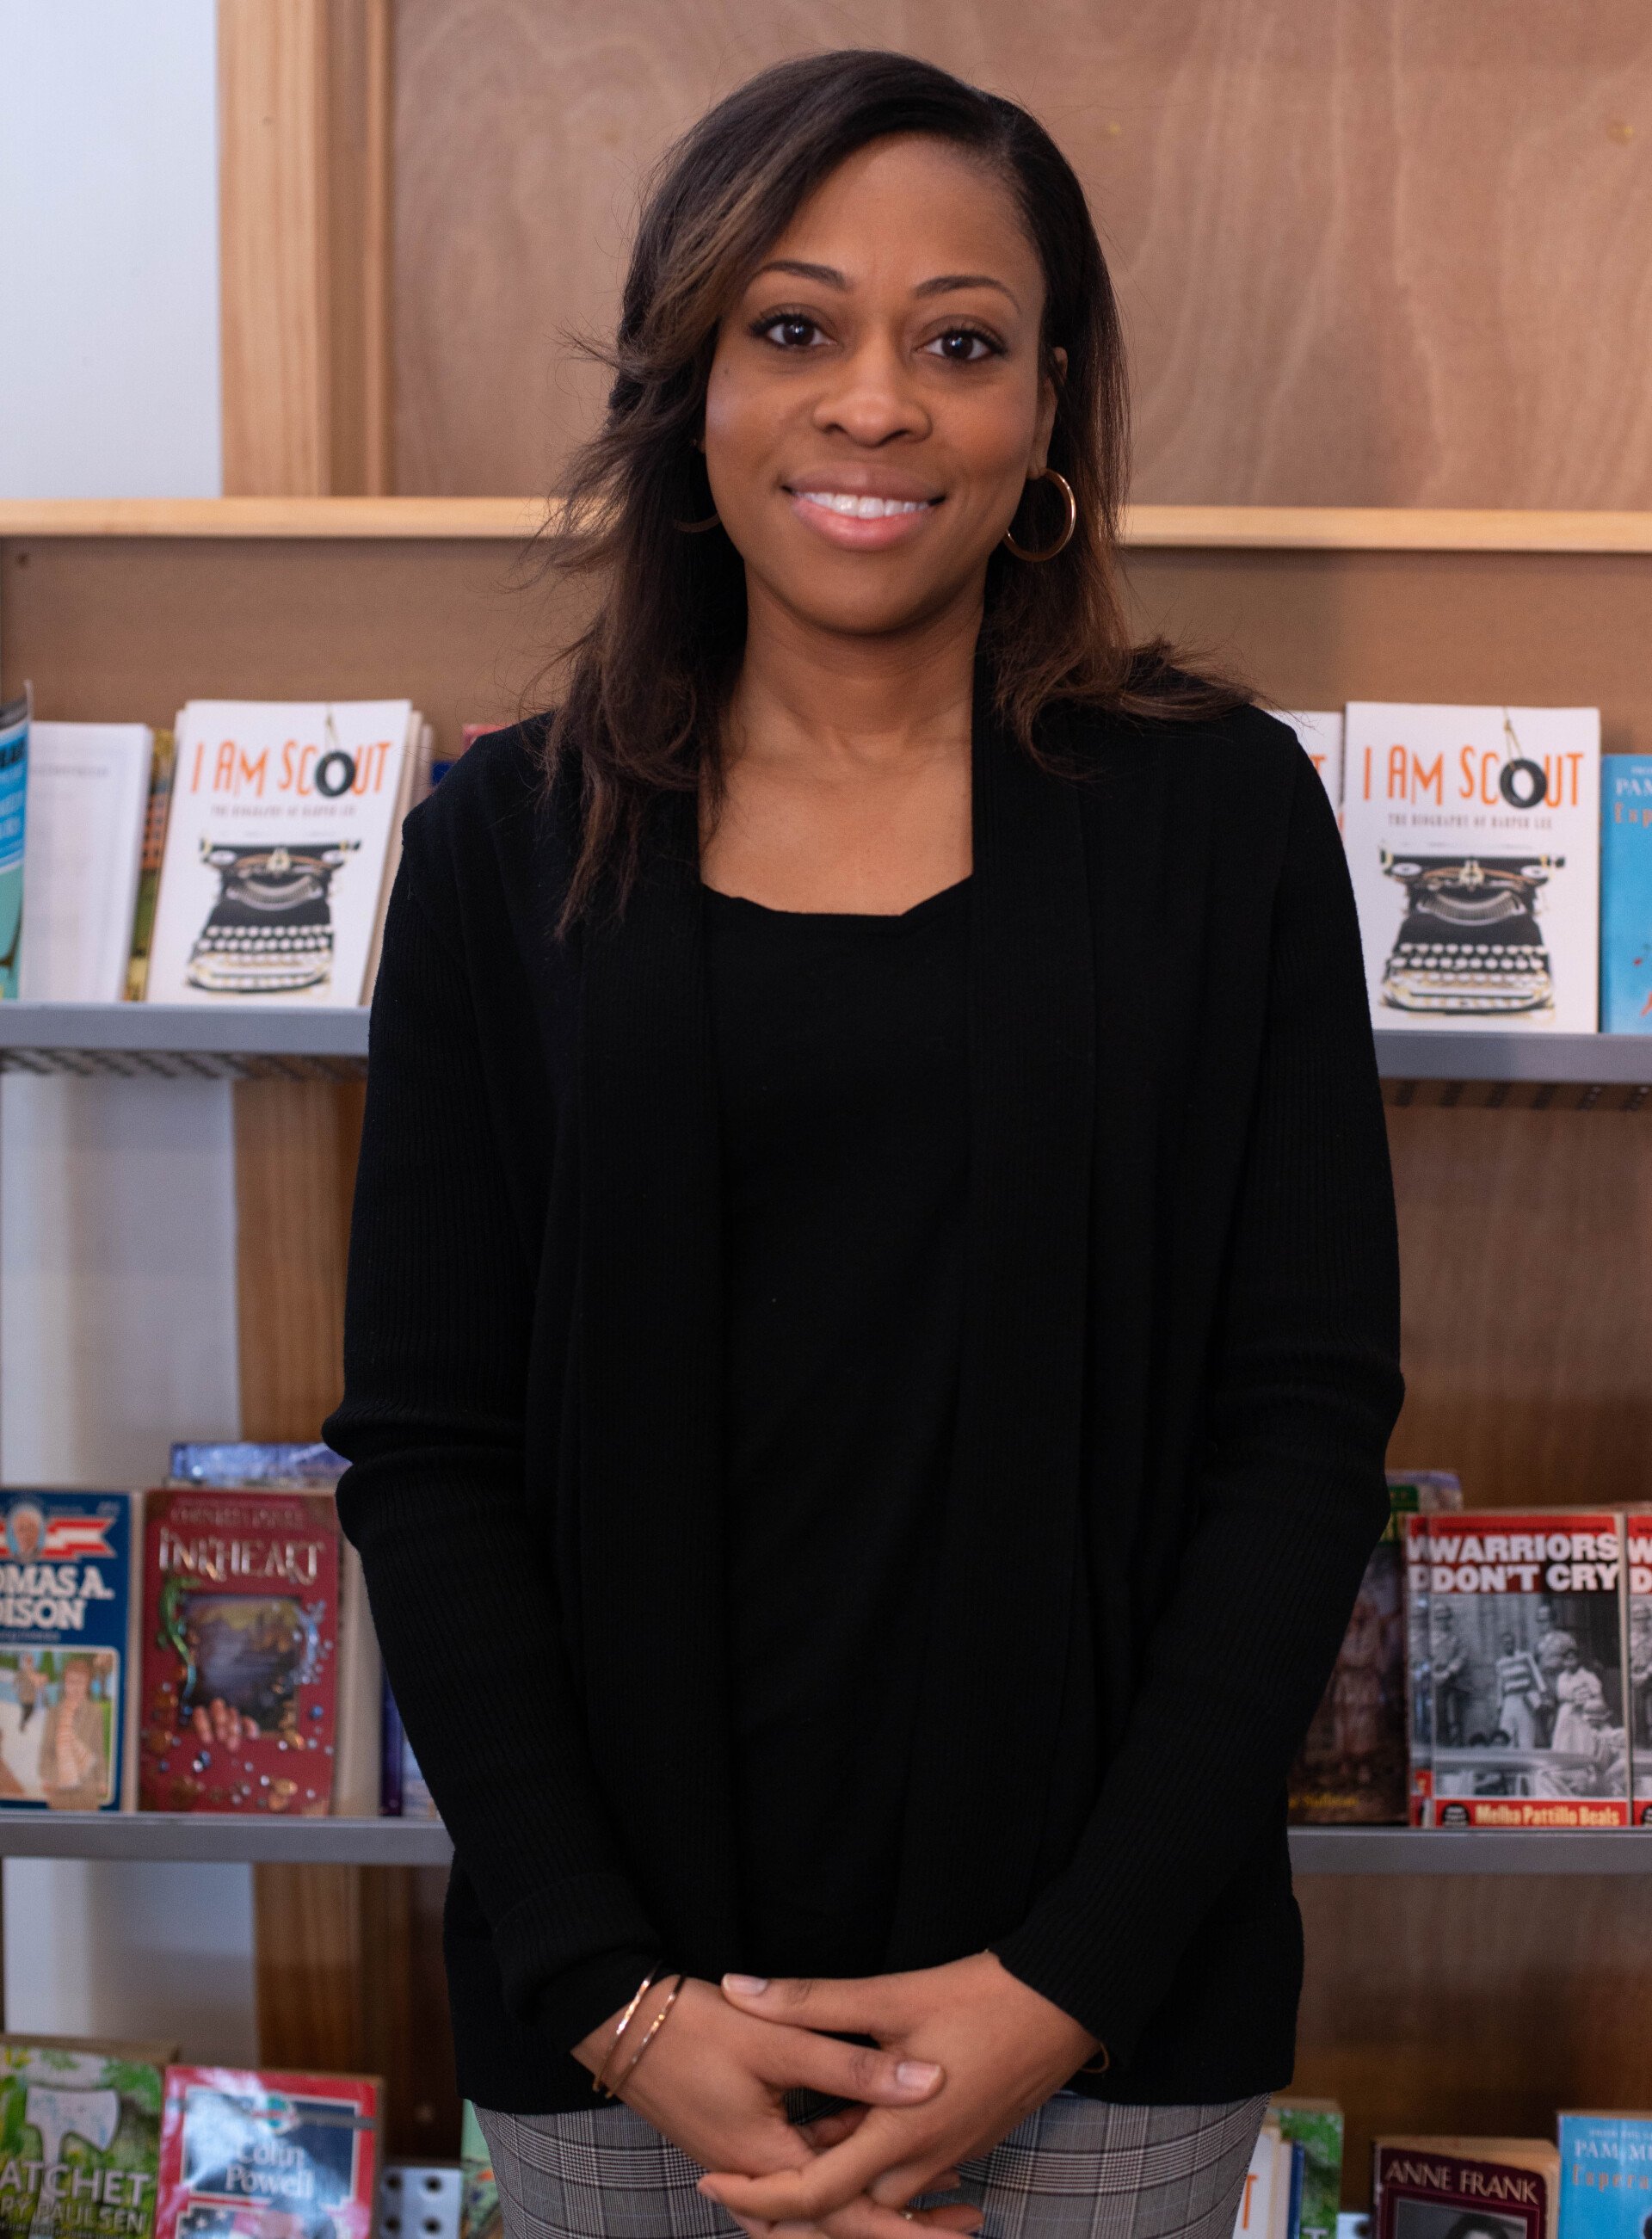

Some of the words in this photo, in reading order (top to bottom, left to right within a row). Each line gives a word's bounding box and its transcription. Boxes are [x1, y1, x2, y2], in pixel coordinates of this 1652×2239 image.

[191, 742, 204, 793] I
[213, 739, 269, 798] AM
[277, 738, 392, 799] SCOUT
[1363, 745, 1372, 801] I
[1387, 744, 1444, 806] AM
[1458, 745, 1584, 809] SCOUT
[1428, 1533, 1619, 1563] WARRIORS
[1432, 1564, 1540, 1592] DON'T
[1546, 1563, 1621, 1592] CRY
[225, 2163, 315, 2200] Powell
[1384, 2160, 1452, 2192] ANNE
[1459, 2169, 1539, 2205] FRANK
